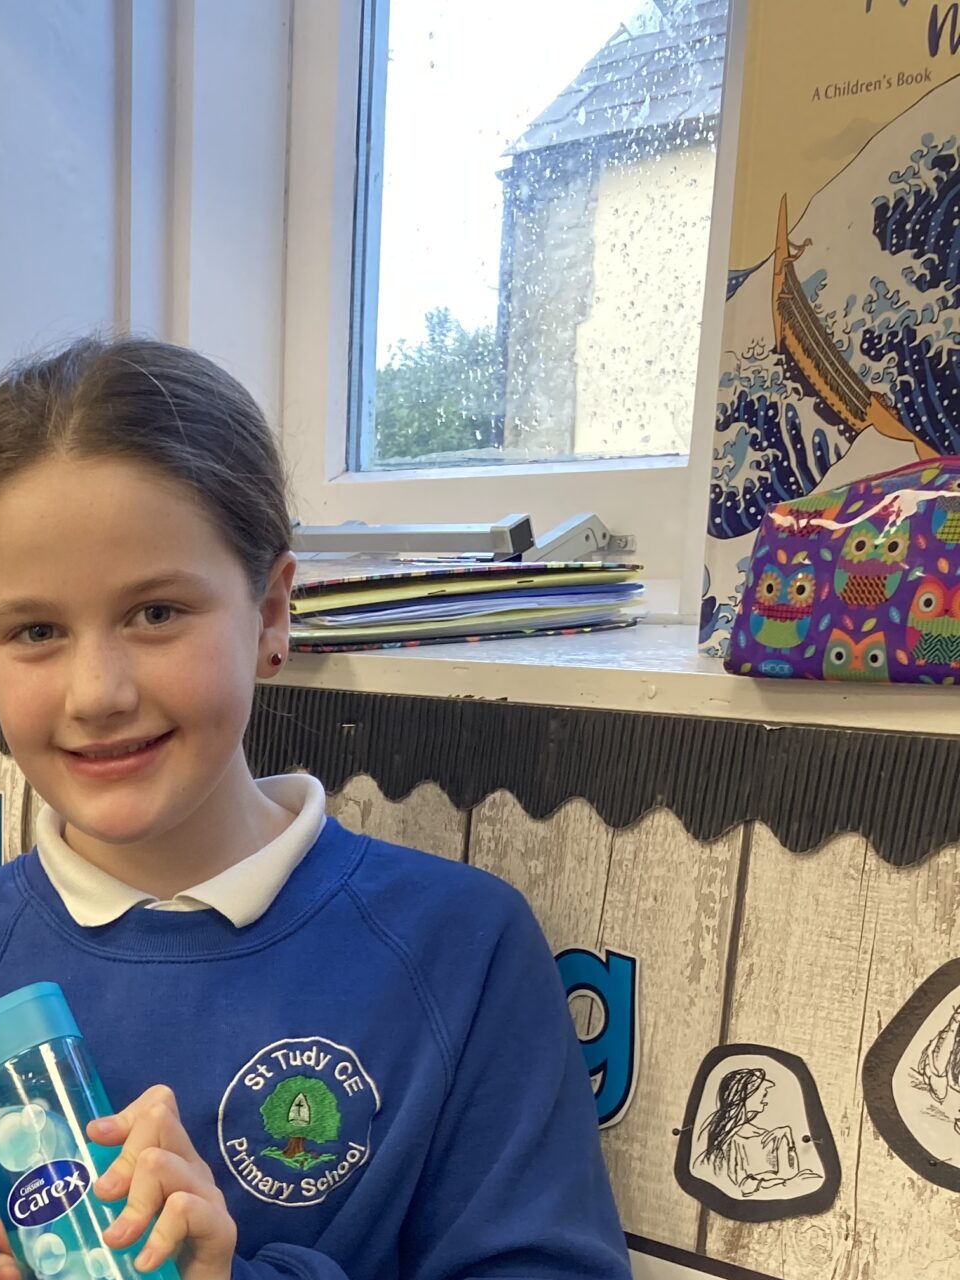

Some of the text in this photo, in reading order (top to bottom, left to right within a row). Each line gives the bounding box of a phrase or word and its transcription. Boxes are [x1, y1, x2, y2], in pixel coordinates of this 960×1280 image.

[811, 67, 932, 101] A Children's Book
[244, 1046, 364, 1097] St Tudy CE
[226, 1137, 366, 1199] Primary School
